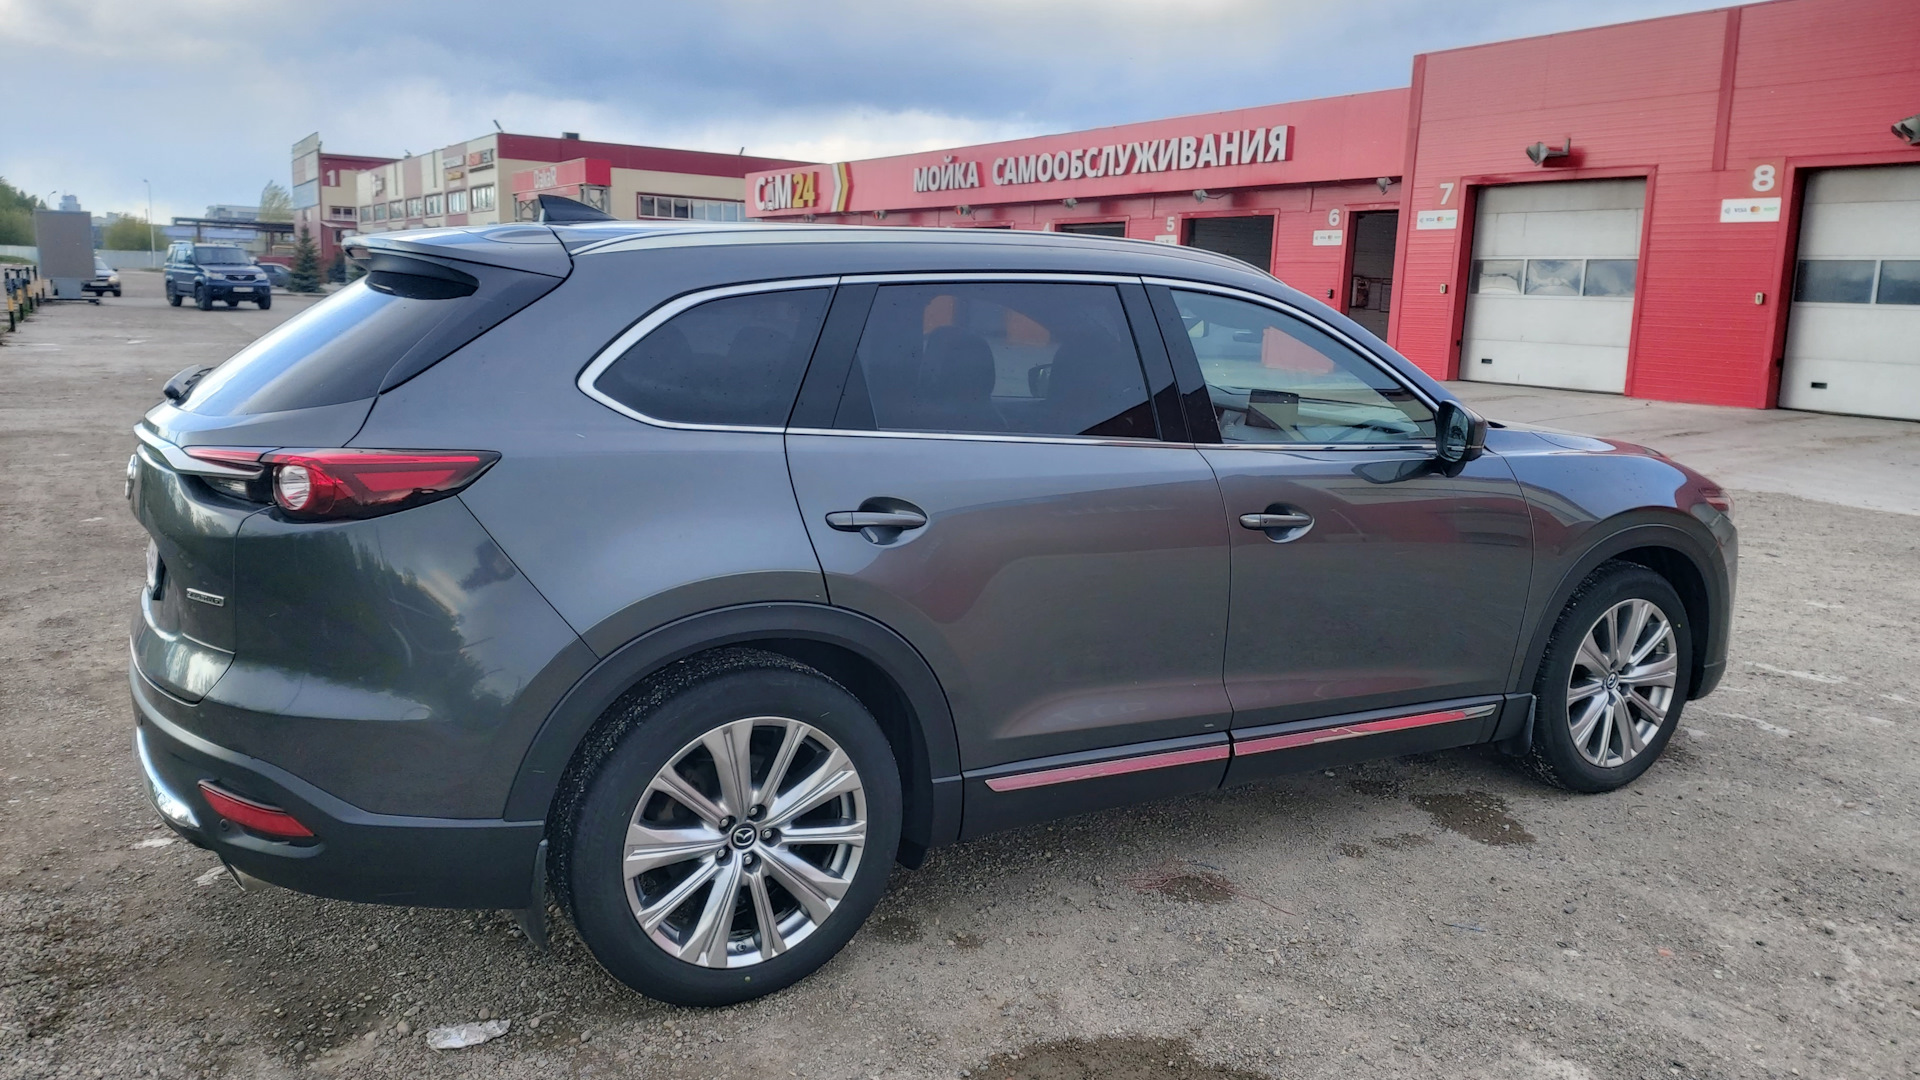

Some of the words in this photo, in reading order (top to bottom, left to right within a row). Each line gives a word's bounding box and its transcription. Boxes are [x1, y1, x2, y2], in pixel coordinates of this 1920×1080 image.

[913, 155, 979, 192] МОЙКА
[992, 125, 1288, 186] САМООБСЛУЖИВАНИЯ
[1752, 164, 1775, 192] 8
[1440, 182, 1454, 205] 7
[1166, 216, 1175, 232] 5
[1328, 208, 1340, 227] 6
